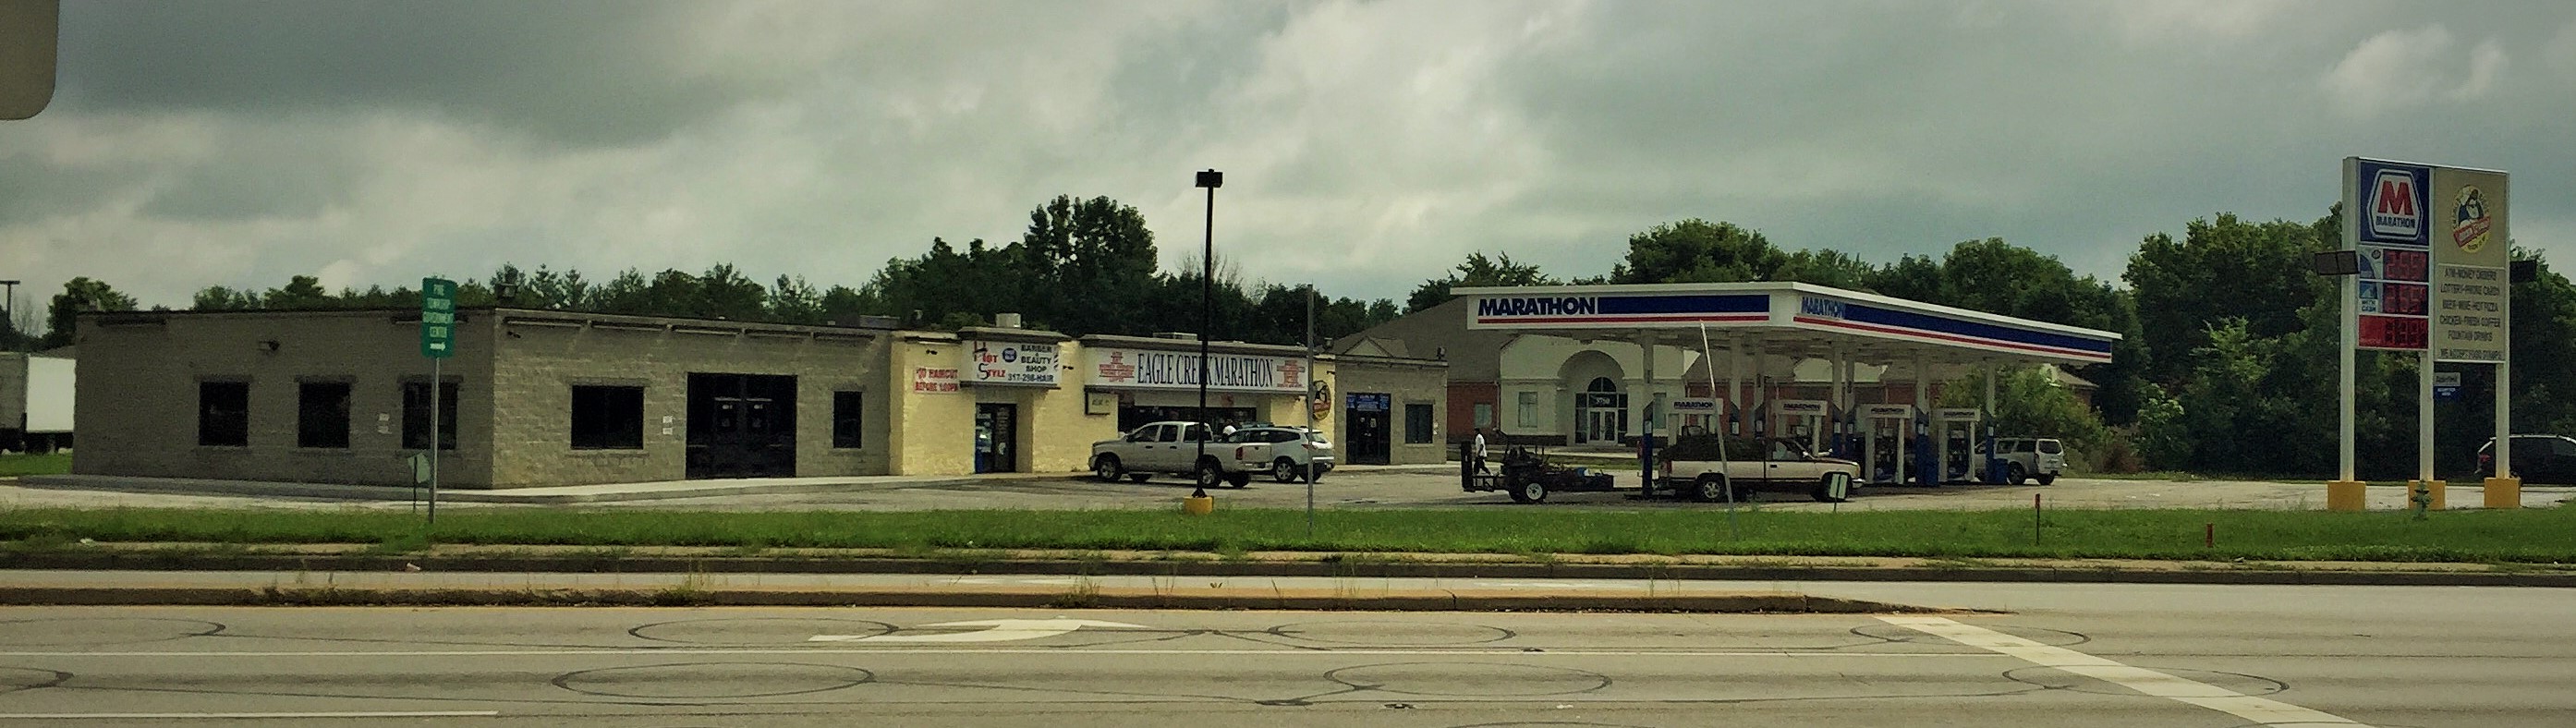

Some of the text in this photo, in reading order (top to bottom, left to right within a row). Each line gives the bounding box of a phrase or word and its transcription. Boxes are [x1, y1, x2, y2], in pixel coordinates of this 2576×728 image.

[2377, 180, 2414, 215] M
[2376, 215, 2416, 228] MARATHON
[1478, 297, 1596, 316] MARATHON
[1801, 296, 1846, 320] MARATHON
[1021, 344, 1052, 354] BARBER
[1021, 357, 1051, 365] BEAUTY
[1137, 353, 1174, 384] EAGLE
[1214, 356, 1273, 387] MARATHON
[915, 382, 938, 392] BEFORE
